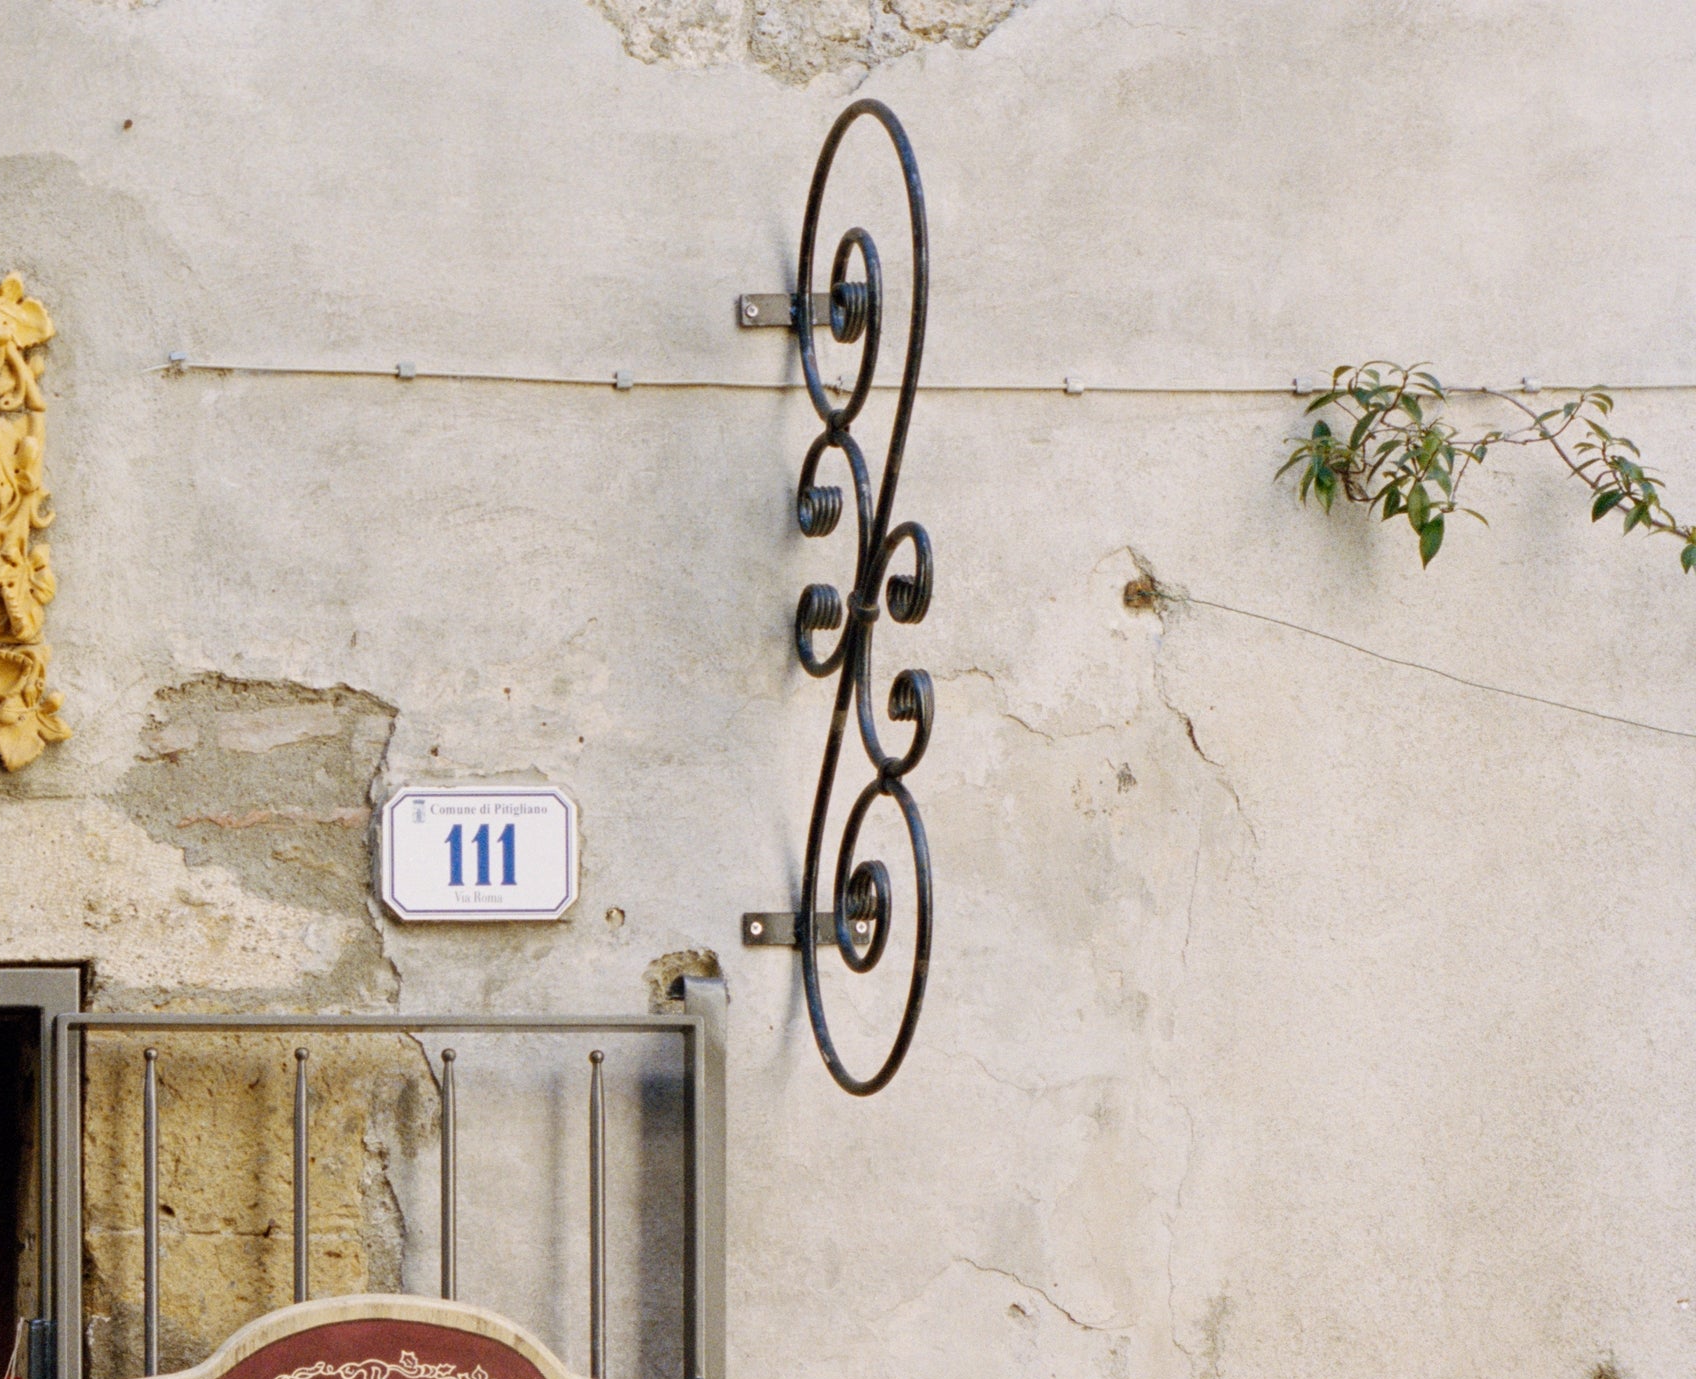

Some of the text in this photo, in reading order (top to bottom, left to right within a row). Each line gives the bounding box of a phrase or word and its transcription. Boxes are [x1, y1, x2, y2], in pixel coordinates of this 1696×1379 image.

[430, 803, 547, 816] Comune di Pitigliano
[444, 824, 517, 886] 111
[455, 891, 503, 903] Via Roma
